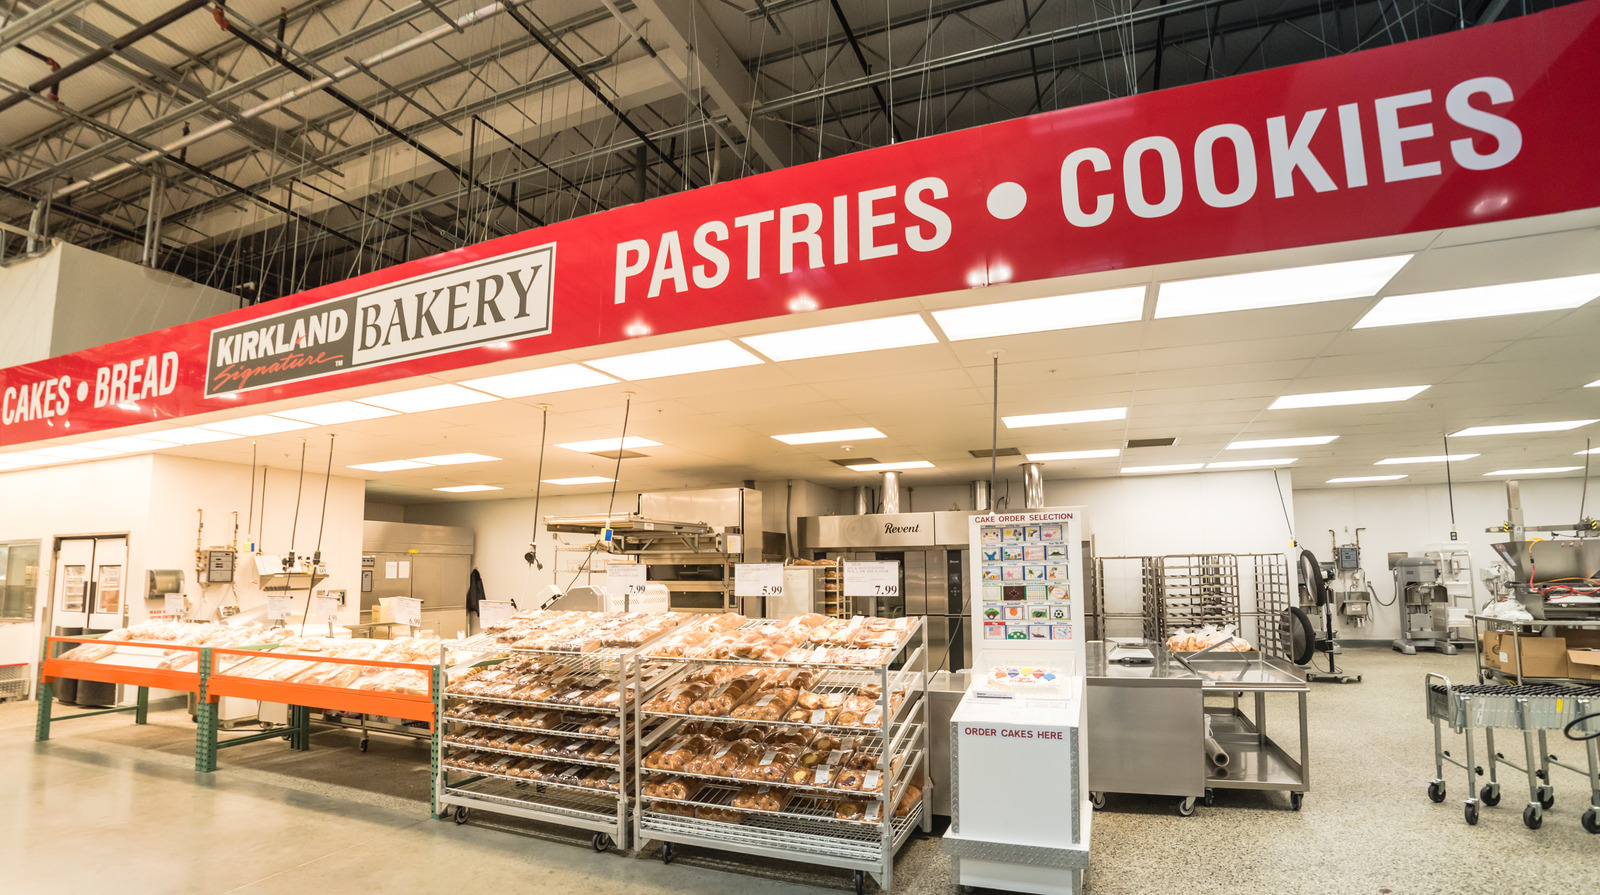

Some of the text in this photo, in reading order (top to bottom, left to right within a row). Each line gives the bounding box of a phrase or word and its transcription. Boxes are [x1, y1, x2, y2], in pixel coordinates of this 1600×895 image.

[614, 76, 1523, 305] PASTRIES COOKIES
[358, 264, 543, 352] BAKERY
[216, 308, 349, 367] KIRKLAND
[212, 351, 344, 392] Signature
[2, 351, 179, 426] CAKES BREAD
[974, 516, 996, 524] CAKE
[1029, 512, 1073, 521] SELECTION
[884, 522, 919, 534] Revent
[629, 585, 646, 593] 7.99
[761, 585, 783, 595] 5.99
[874, 585, 898, 595] 7.99
[964, 727, 1063, 740] ORDER CAKES HERE
